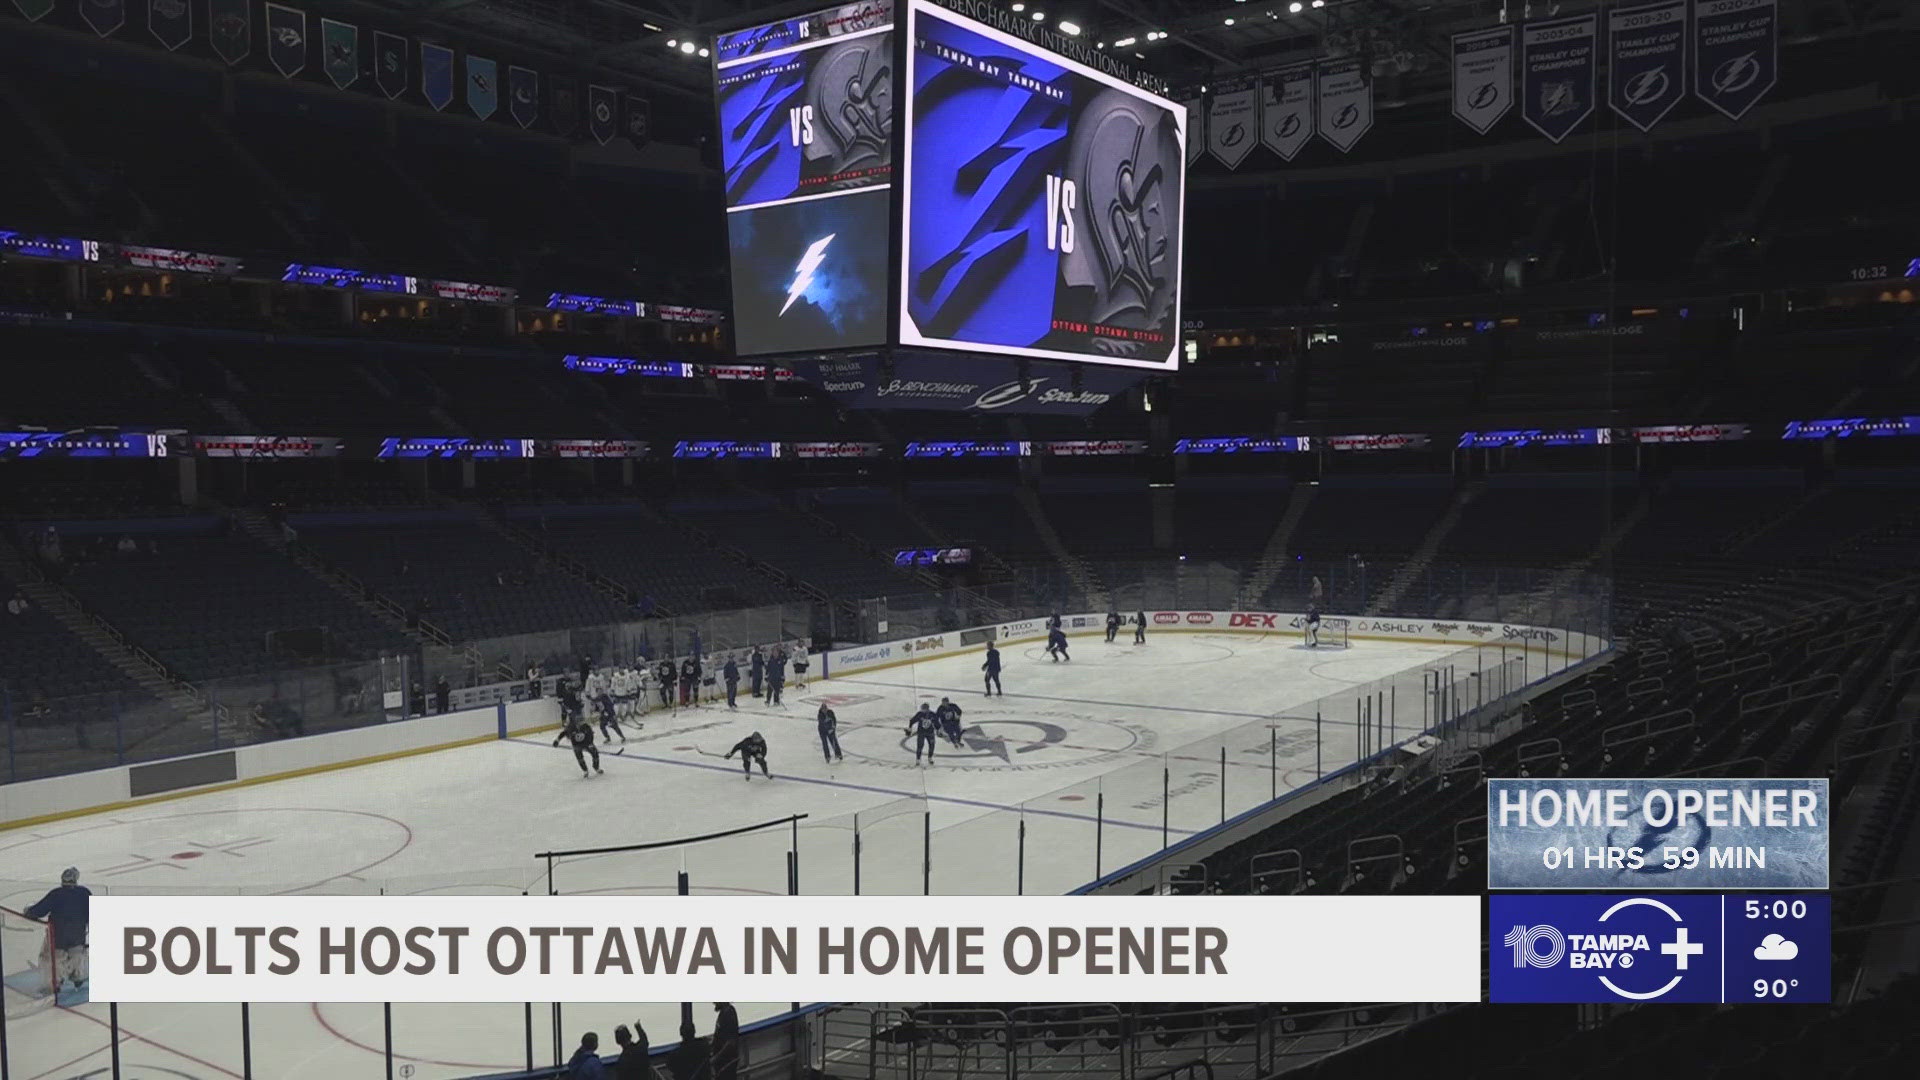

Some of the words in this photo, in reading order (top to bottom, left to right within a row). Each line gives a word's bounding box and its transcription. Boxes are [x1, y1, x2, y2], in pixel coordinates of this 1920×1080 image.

[799, 21, 810, 39] VS
[1536, 26, 1584, 42] 2003-04
[1041, 28, 1132, 82] INTERNATIONAL
[1136, 70, 1169, 96] ARENA
[936, 45, 973, 68] TAMPA
[979, 60, 999, 77] BAY
[1008, 71, 1041, 92] TAMPA
[1045, 85, 1064, 99] BAY
[790, 105, 814, 147] VS
[1046, 174, 1076, 254] VS
[82, 240, 99, 262] VS
[1851, 265, 1887, 280] 10:32
[405, 276, 417, 294] VS
[635, 301, 646, 318] VS
[1052, 319, 1089, 334] OTTAWA
[1094, 323, 1129, 339] OTTAWA
[682, 362, 694, 378] VS
[1297, 436, 1310, 451] VS
[1597, 428, 1611, 444] VS
[147, 434, 167, 457] VS
[521, 439, 535, 458] VS
[771, 442, 781, 458] VS
[1019, 441, 1032, 456] VS
[1010, 622, 1033, 631] TECO
[1228, 613, 1278, 629] DEX
[1371, 621, 1424, 634] ASHLEY
[1432, 622, 1459, 631] Mosaic
[840, 653, 863, 665] Florida
[864, 651, 878, 662] Blue
